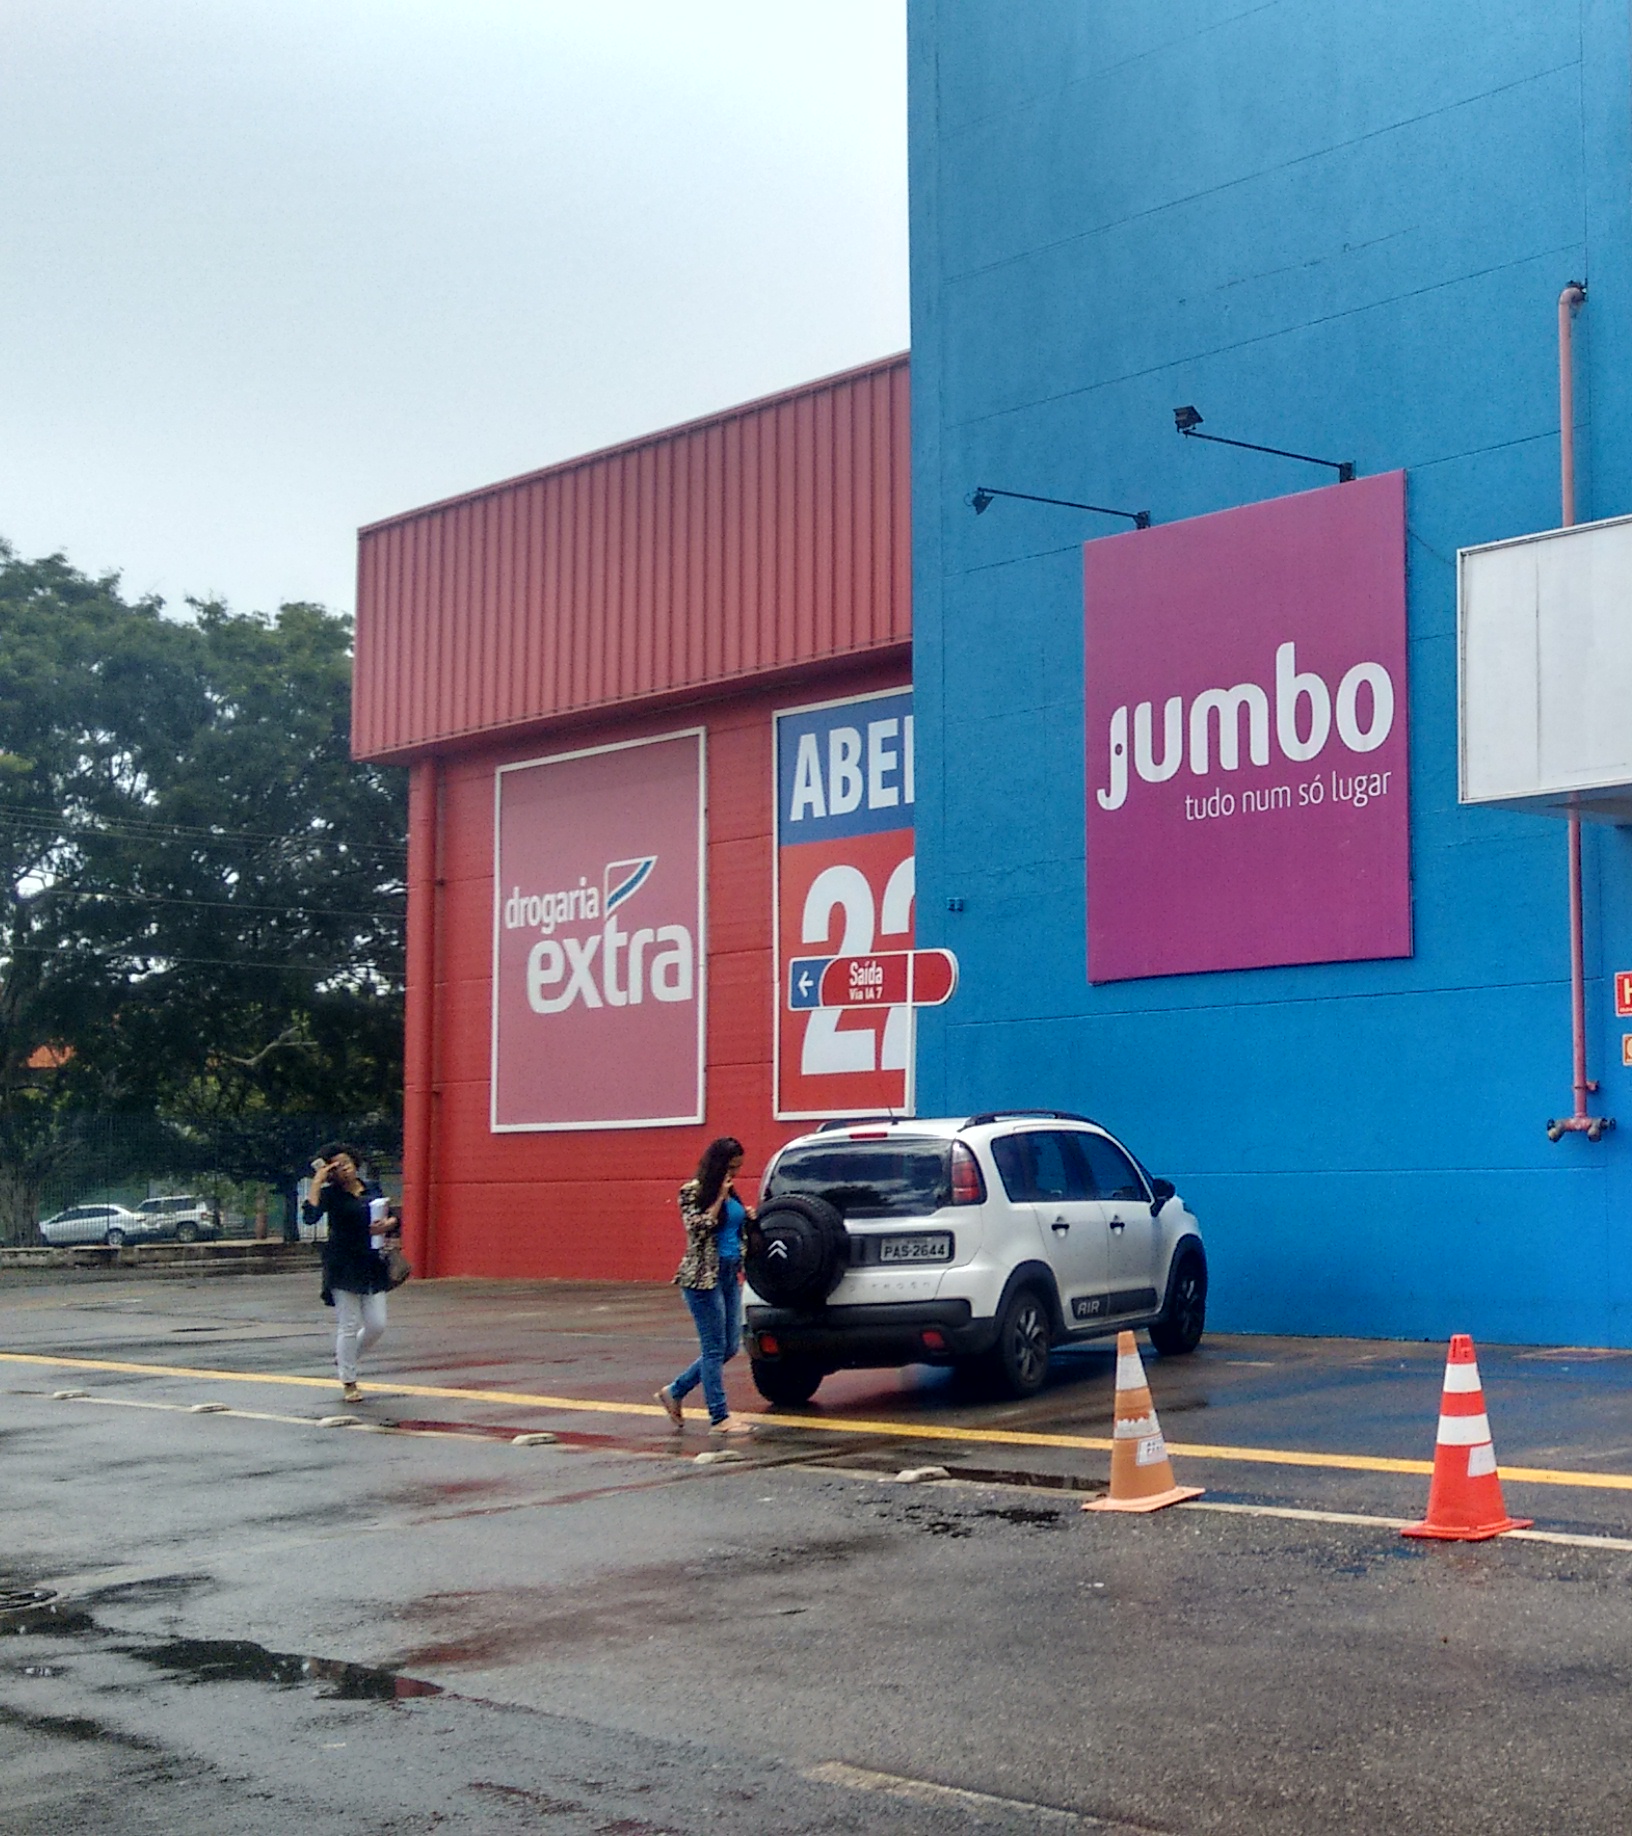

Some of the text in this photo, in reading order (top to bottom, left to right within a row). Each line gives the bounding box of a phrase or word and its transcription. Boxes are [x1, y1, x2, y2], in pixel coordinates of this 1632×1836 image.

[1097, 641, 1394, 810] jumbo
[1185, 771, 1391, 821] tudo num só lugar
[504, 877, 600, 935] drogaria
[527, 914, 694, 1014] extra
[849, 960, 883, 986] Saída
[848, 987, 864, 1000] Via
[876, 986, 883, 999] 7
[884, 1243, 945, 1258] PAS-2644
[1077, 1300, 1100, 1316] AIR
